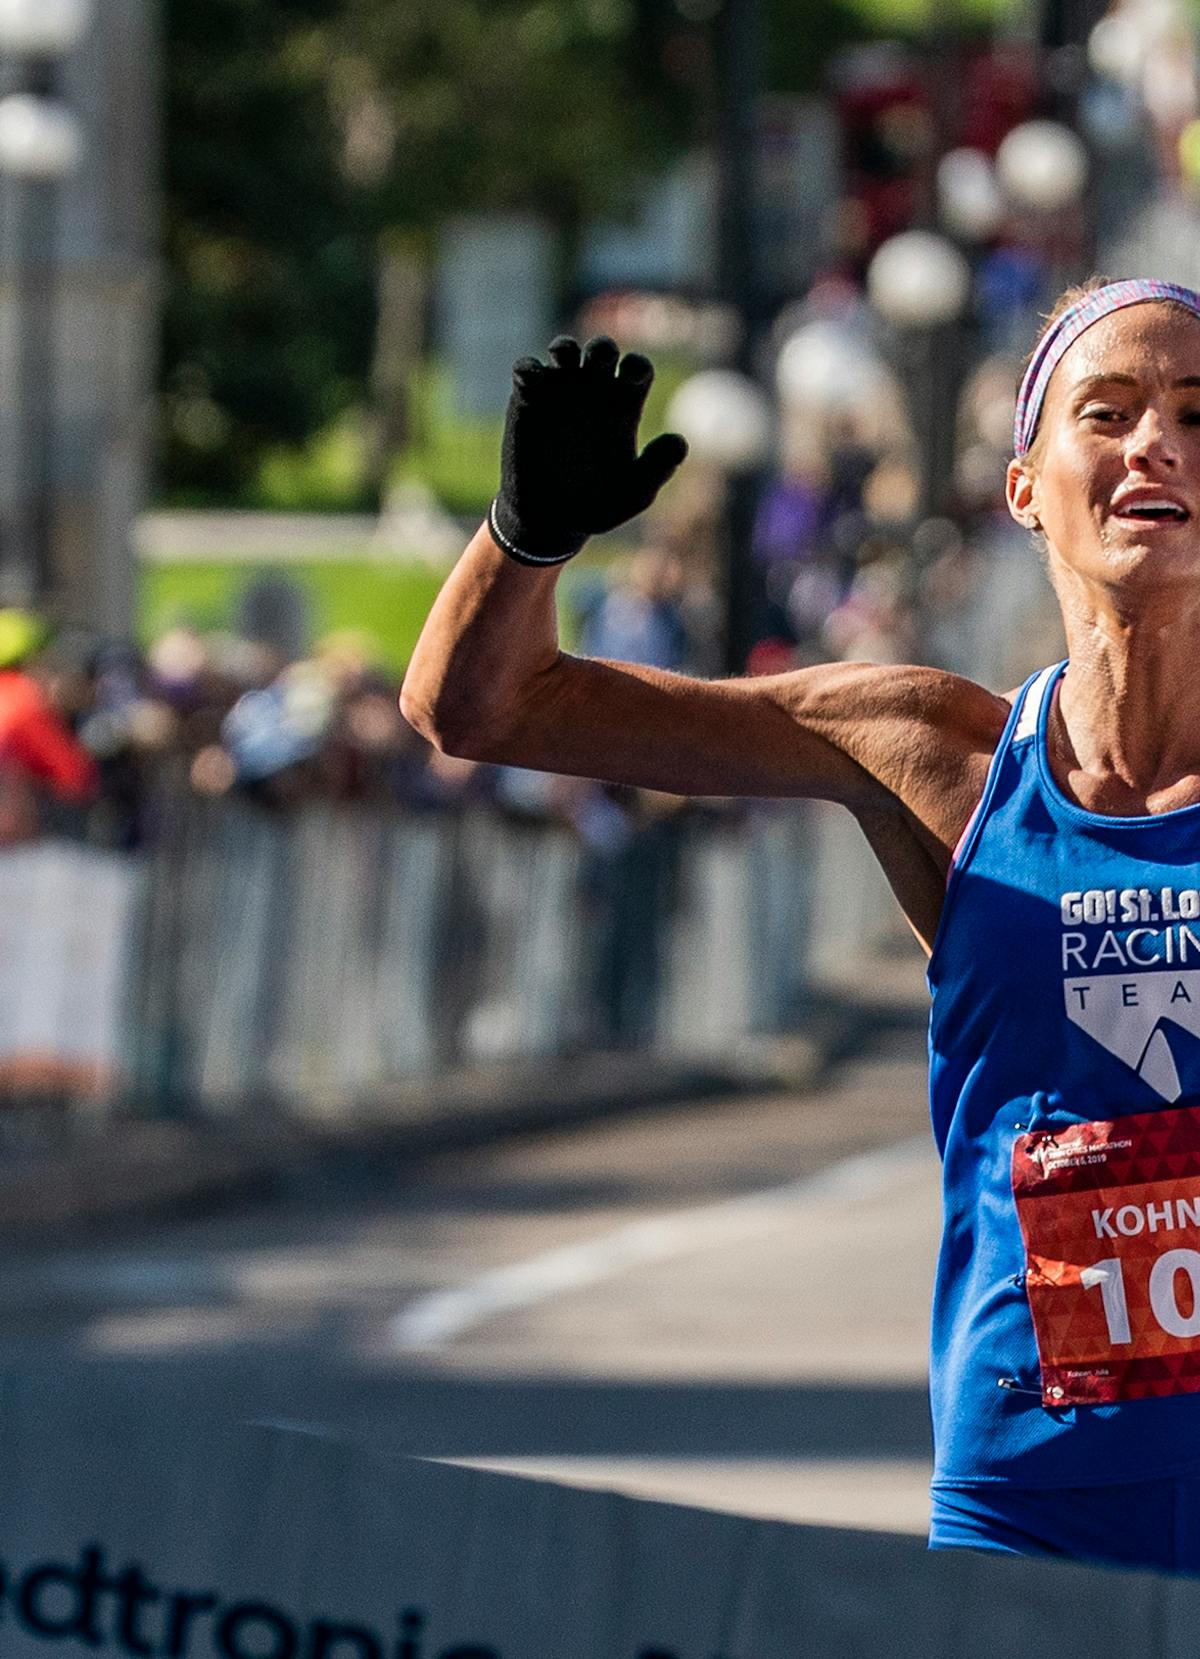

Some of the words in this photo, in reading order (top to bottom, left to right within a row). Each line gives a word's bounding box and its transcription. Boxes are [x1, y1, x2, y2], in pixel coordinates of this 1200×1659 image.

[1060, 889, 1117, 926] GO!
[1120, 888, 1159, 923] St.
[1088, 1154, 1107, 1164] 2019
